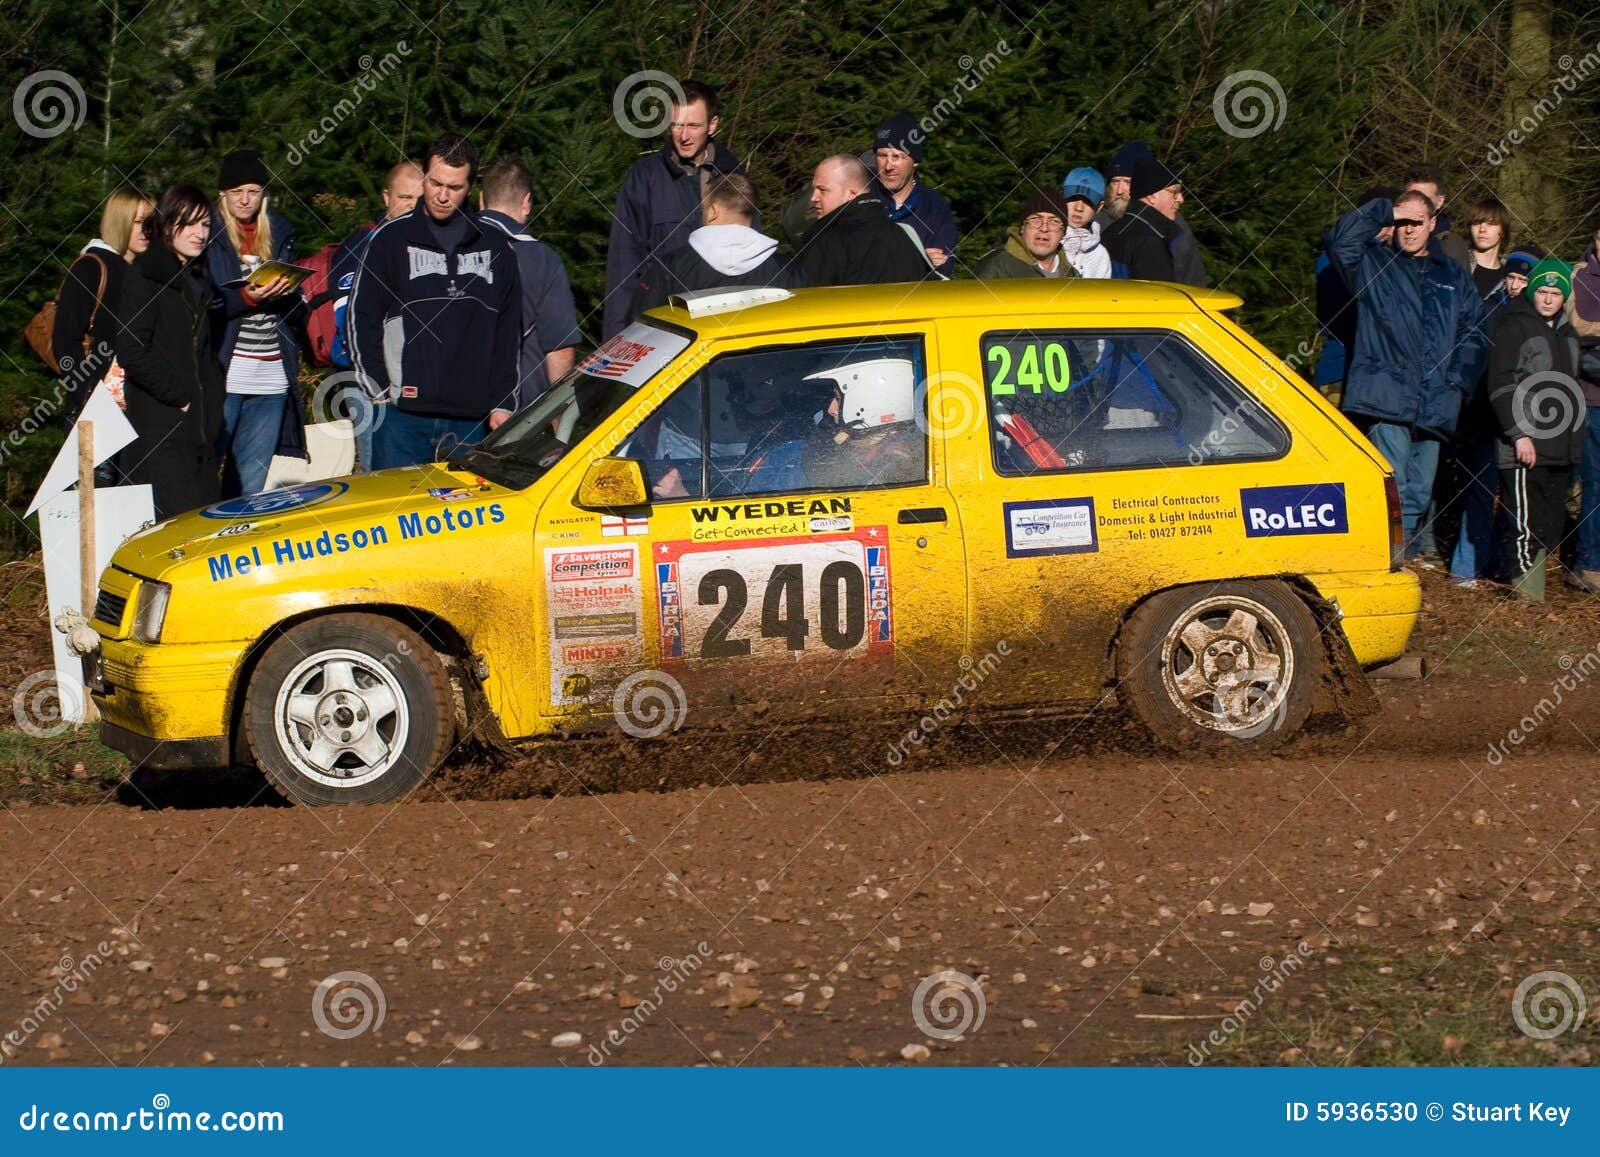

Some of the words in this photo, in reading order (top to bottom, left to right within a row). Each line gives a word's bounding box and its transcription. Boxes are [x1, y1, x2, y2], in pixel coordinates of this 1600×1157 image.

[988, 343, 1070, 395] 240
[691, 497, 851, 523] WYEDEAN
[1112, 495, 1158, 509] Electrical
[1162, 494, 1220, 507] Contractors
[549, 516, 596, 525] NAVIGATOR
[1099, 513, 1145, 526] Domestic
[1149, 513, 1156, 524] &
[1160, 510, 1184, 525] Light
[1188, 508, 1237, 522] Industrial
[1250, 503, 1336, 530] RoLEC
[1128, 529, 1146, 540] Tel:
[1150, 527, 1176, 539] 01427
[1180, 525, 1212, 537] 872414
[208, 546, 262, 582] Mel
[272, 524, 388, 566] Hudson
[397, 503, 505, 540] Motors
[569, 551, 631, 562] SILVERSTONE
[554, 560, 629, 577] Competition
[574, 584, 635, 597] Holpak
[698, 560, 865, 659] 240
[567, 646, 625, 661] MINTEX
